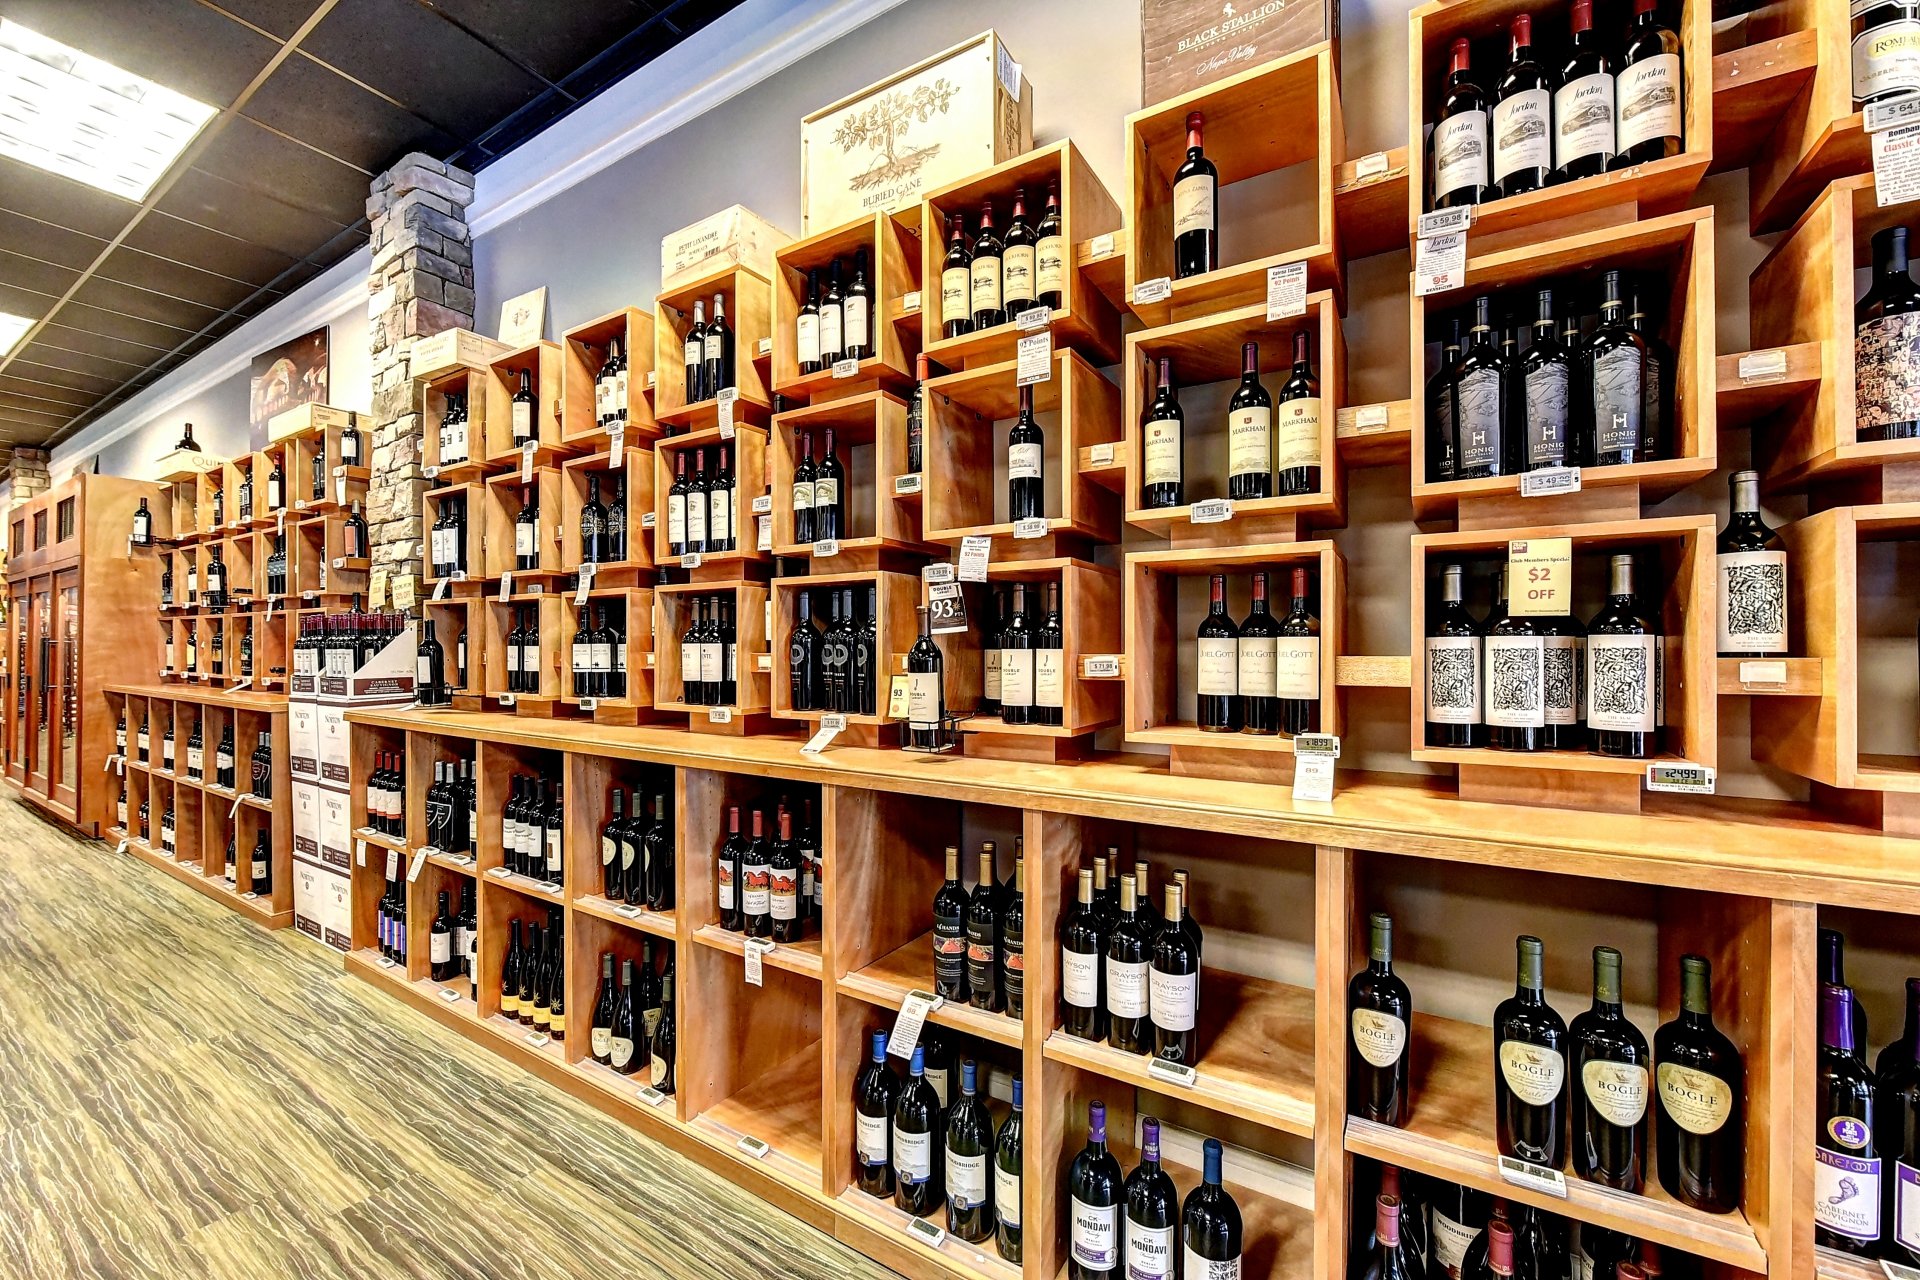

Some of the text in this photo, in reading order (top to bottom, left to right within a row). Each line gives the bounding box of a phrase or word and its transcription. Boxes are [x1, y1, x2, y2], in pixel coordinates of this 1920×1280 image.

[1178, 0, 1285, 51] BLACK STALLION
[1196, 44, 1258, 76] Napa Valley
[1627, 67, 1666, 89] Jordan
[1567, 86, 1603, 106] Jordan
[1503, 101, 1538, 121] Jordan
[1442, 122, 1473, 143] Jordan
[1884, 140, 1914, 153] Classic
[863, 188, 895, 207] BURIED
[896, 178, 922, 195] CANE
[679, 242, 693, 253] PETIT
[1425, 237, 1457, 251] Jordan
[1433, 274, 1448, 284] 95
[1029, 337, 1049, 347] Points
[1282, 417, 1318, 428] MARKHAM
[1232, 425, 1266, 436] MARKHAM
[1603, 430, 1636, 439] HONIG
[1146, 437, 1175, 447] MARKHAM
[1534, 442, 1565, 451] HONIG
[1465, 446, 1495, 456] HONIG
[1528, 567, 1551, 583] $2
[1528, 590, 1555, 600] OFF
[932, 600, 954, 619] 93
[1215, 650, 1235, 658] GOTT
[1256, 650, 1276, 658] GOTT
[1290, 650, 1314, 658] GOTT
[1665, 769, 1698, 779] $24.99
[1110, 969, 1148, 980] GRAYSON
[1360, 1025, 1396, 1041] BOGLE
[1512, 1060, 1554, 1077] BOGLE
[1598, 1080, 1643, 1095] BOGLE
[1668, 1082, 1718, 1105] BOGLE
[1818, 1201, 1866, 1220] CABERNET
[1077, 1217, 1111, 1232] MONDAVI
[1437, 1217, 1475, 1240] WOODBRID
[1132, 1238, 1167, 1255] MONDAVI
